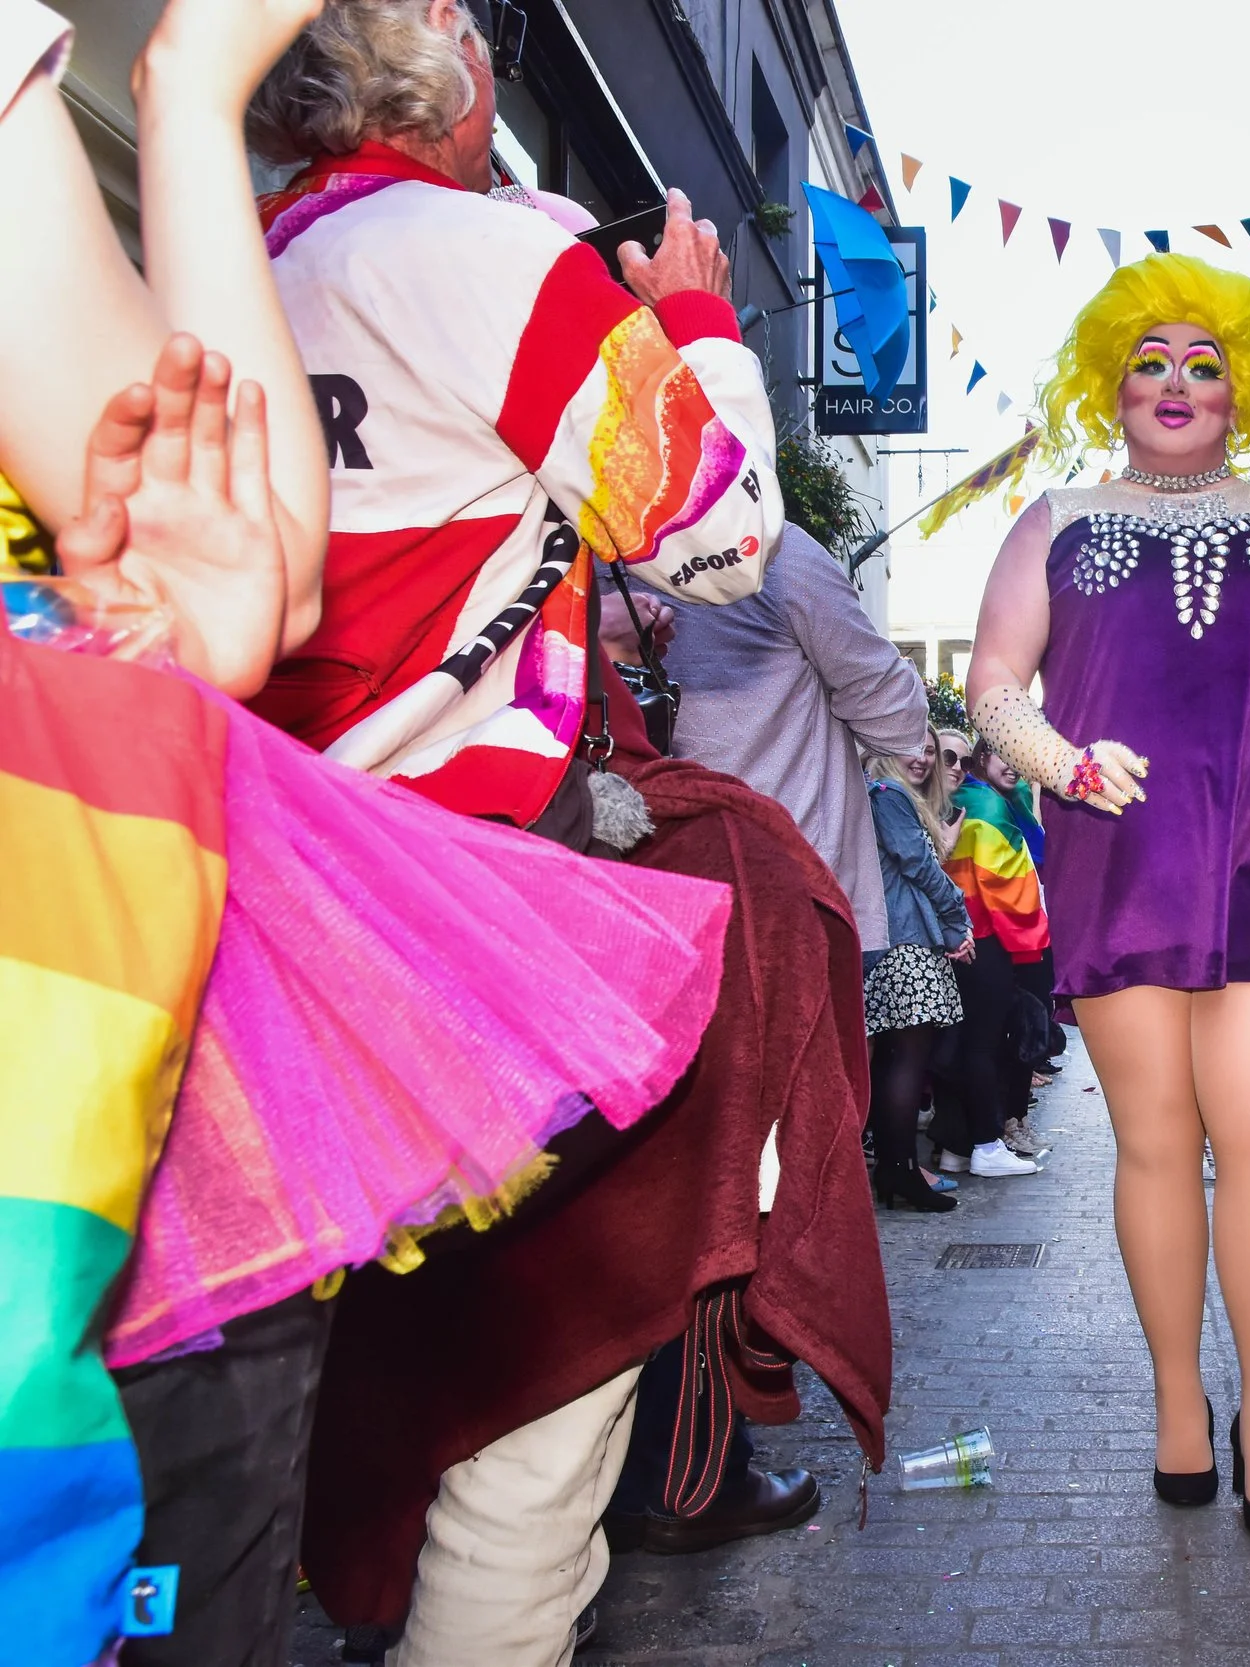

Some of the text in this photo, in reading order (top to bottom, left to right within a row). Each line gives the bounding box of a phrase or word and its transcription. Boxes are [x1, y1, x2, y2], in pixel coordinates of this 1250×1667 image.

[825, 398, 917, 414] HAIR CO.
[670, 547, 743, 586] FAGOR
